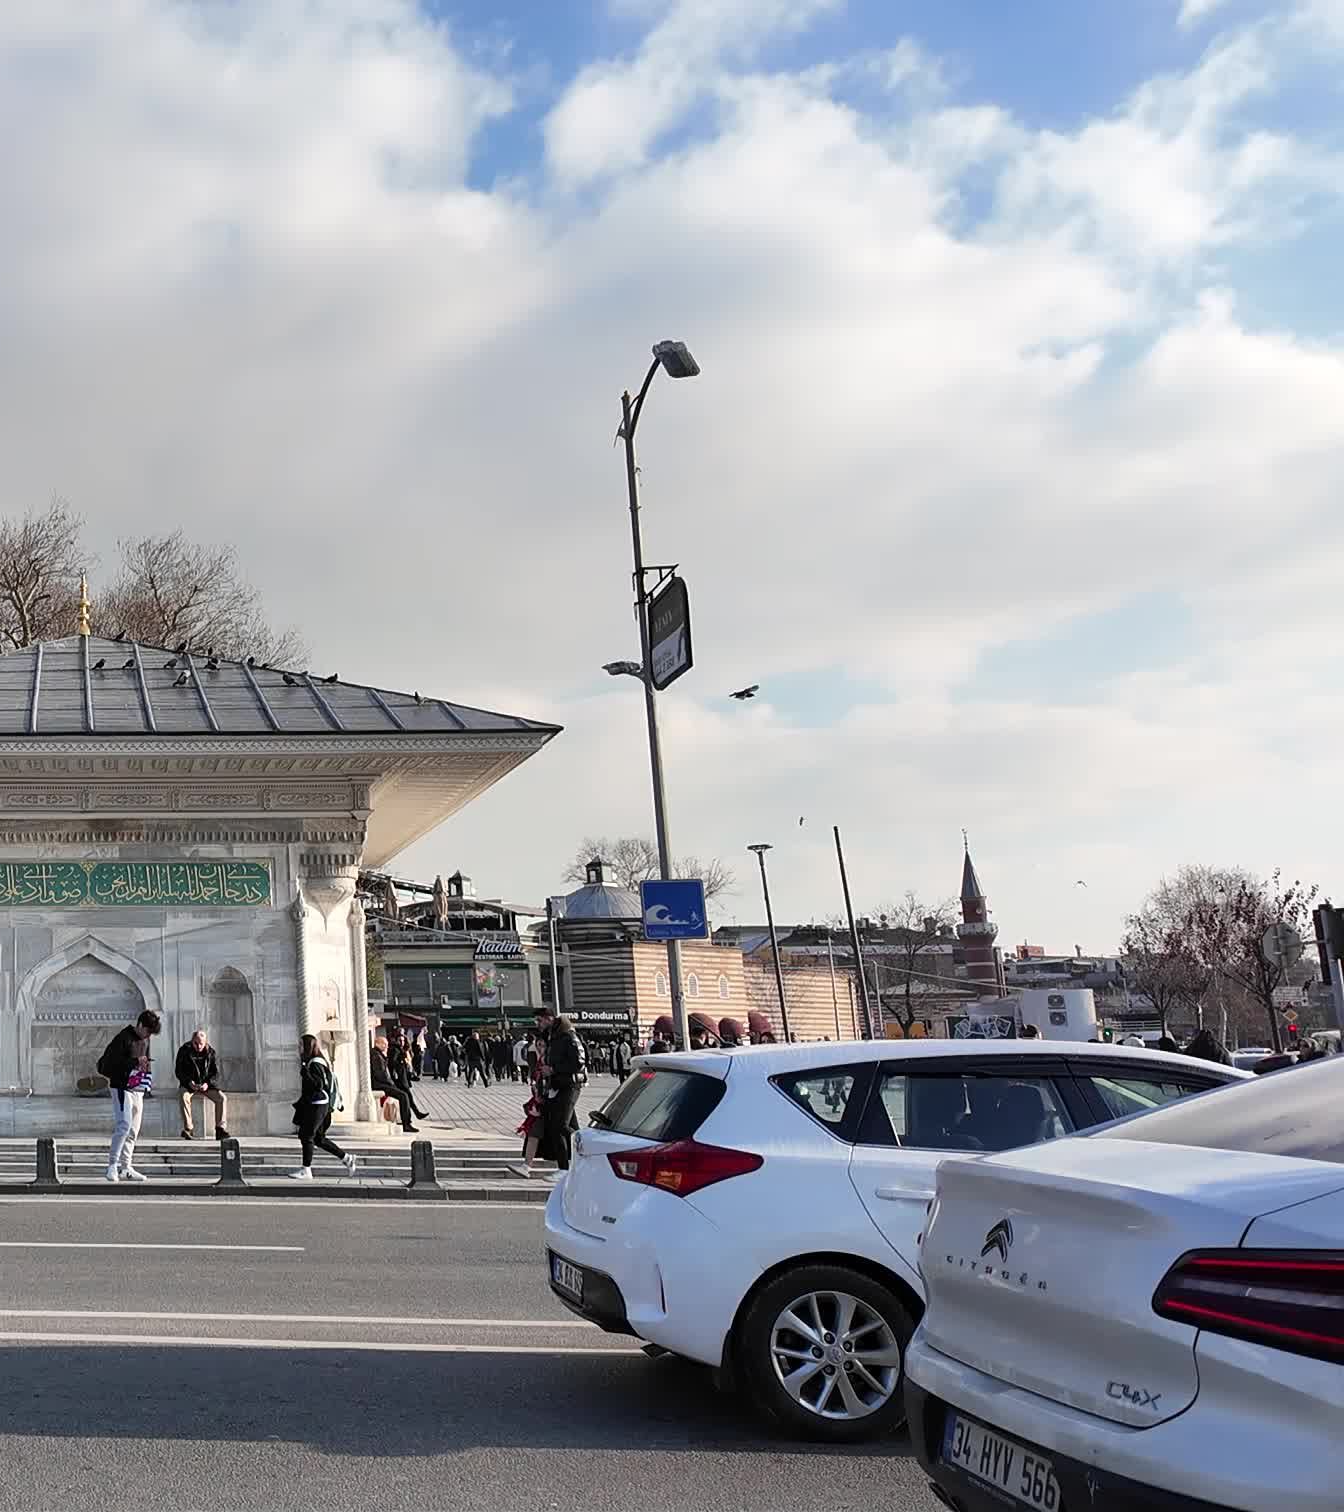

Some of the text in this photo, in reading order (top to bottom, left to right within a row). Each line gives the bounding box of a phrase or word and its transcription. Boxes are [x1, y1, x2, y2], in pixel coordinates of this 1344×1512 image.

[475, 936, 523, 953] Kadim
[581, 1011, 628, 1020] Dondurma
[953, 1422, 971, 1465] 34
[979, 1435, 1014, 1486] HYV
[1021, 1455, 1057, 1510] 566
